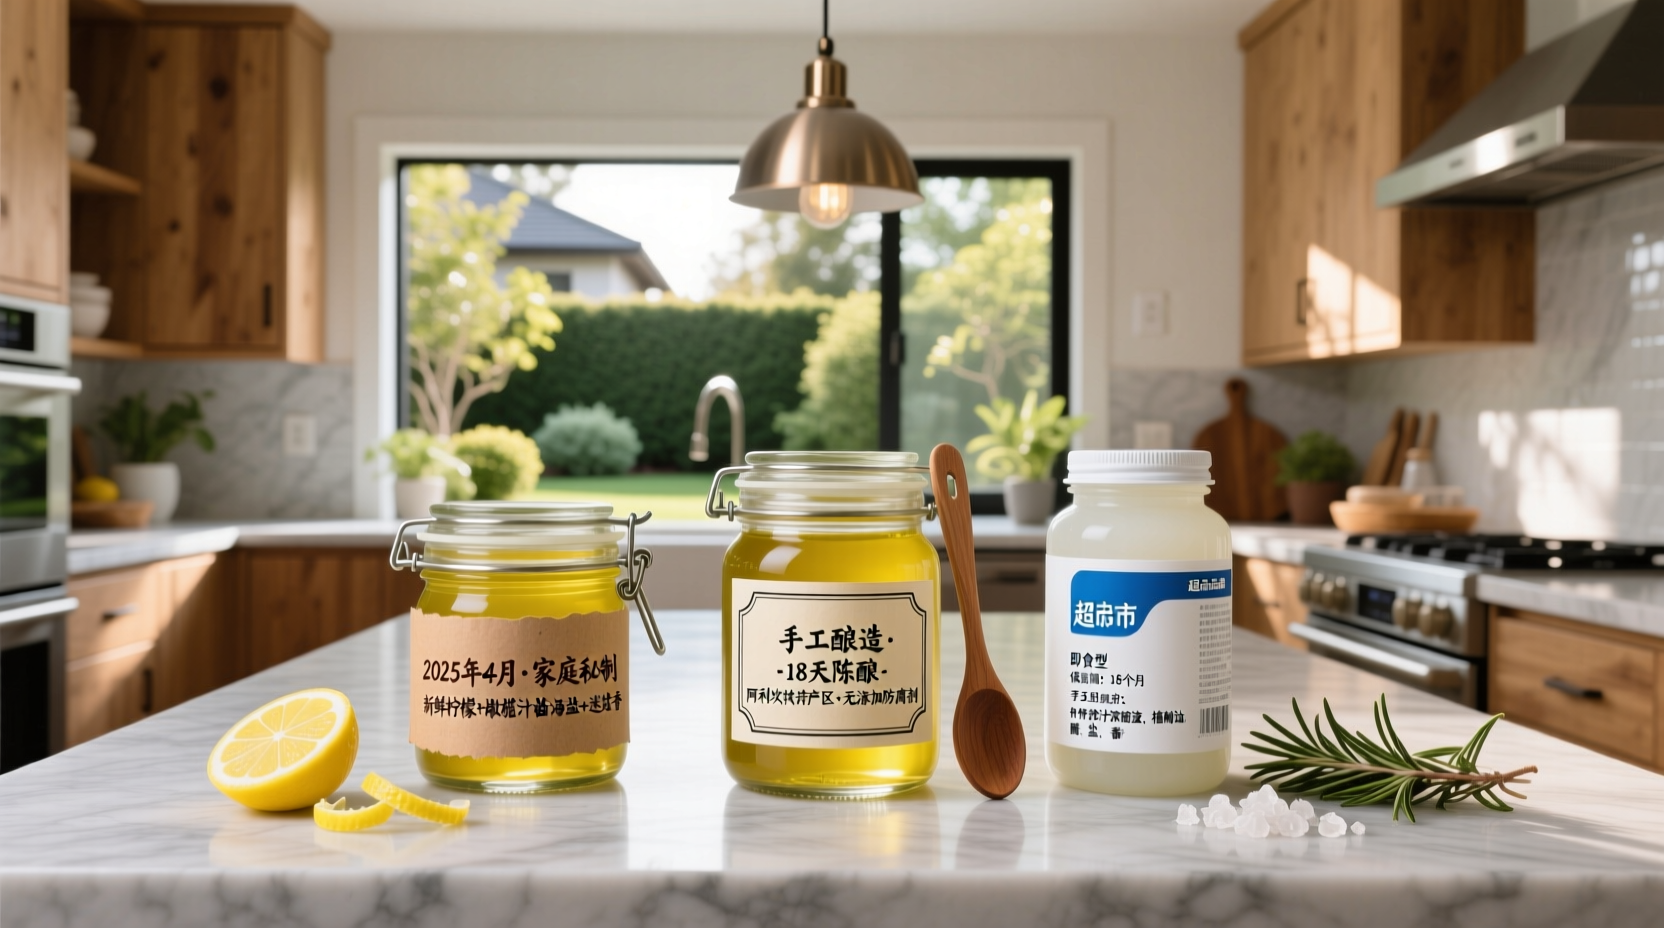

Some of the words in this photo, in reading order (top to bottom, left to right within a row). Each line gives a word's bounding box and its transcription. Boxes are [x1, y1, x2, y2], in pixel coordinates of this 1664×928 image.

[423, 653, 617, 688] 2025年4月·家庭私制
